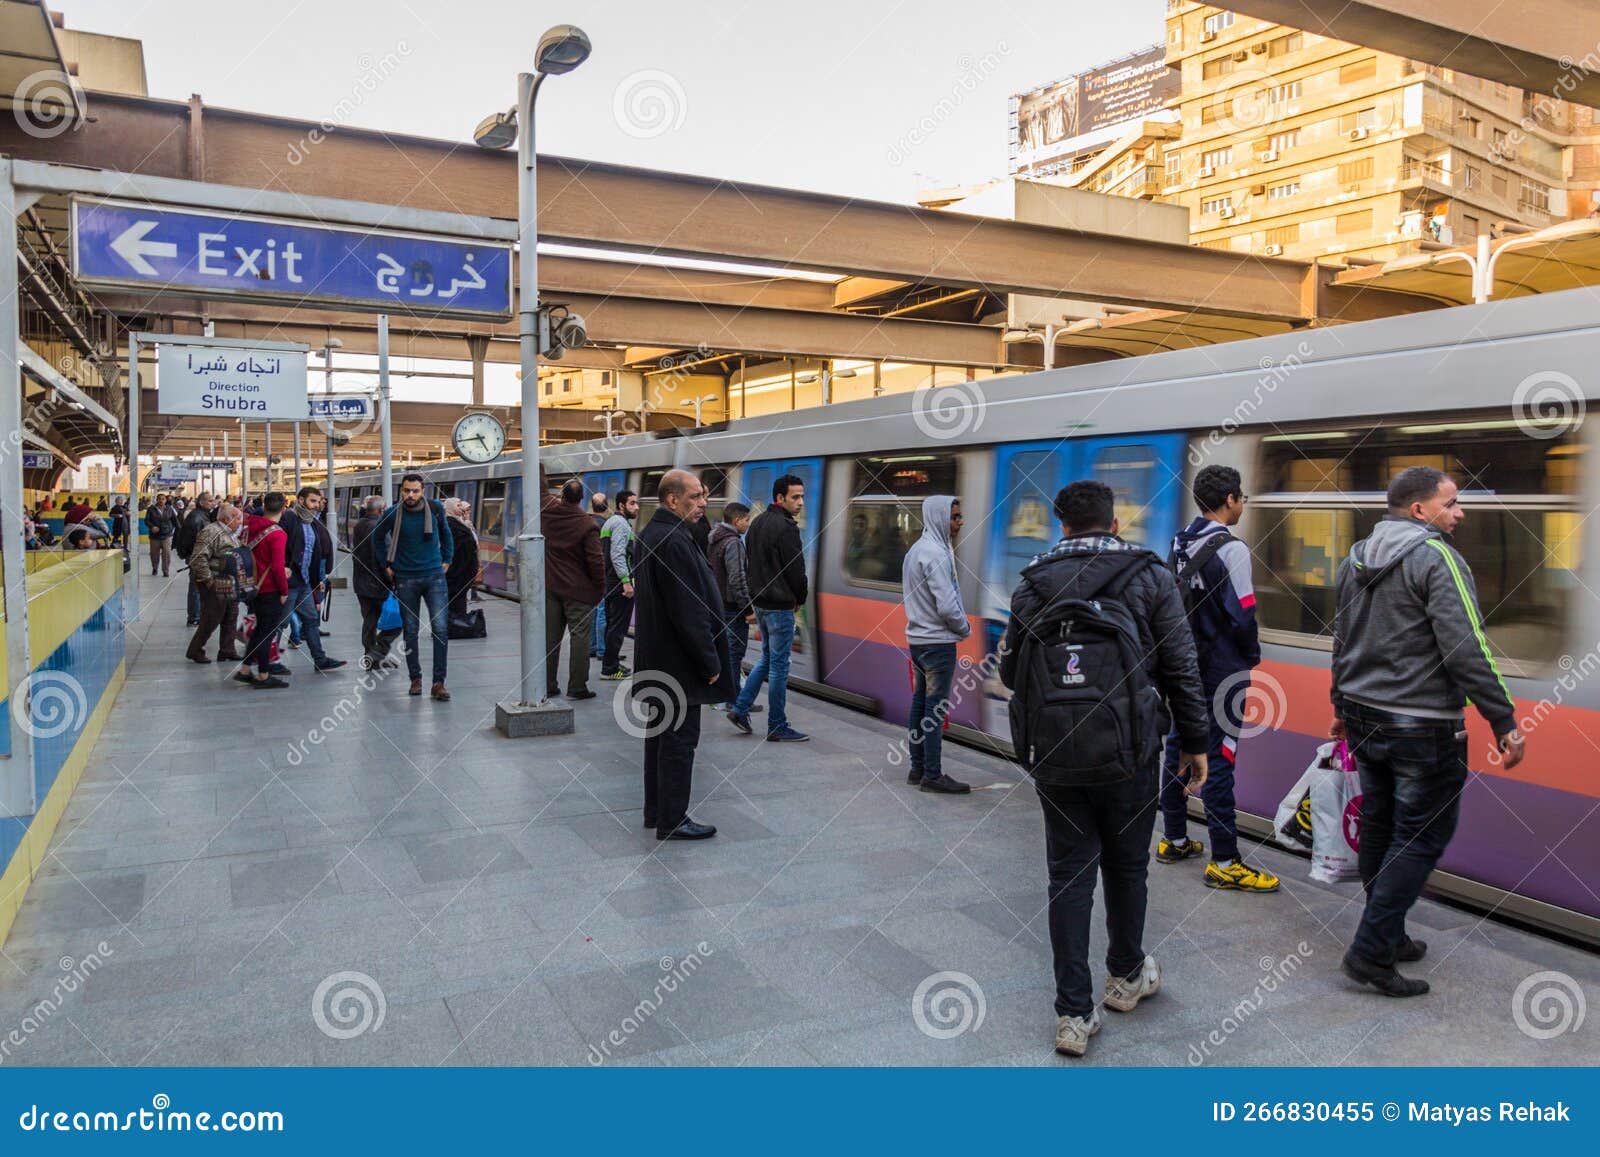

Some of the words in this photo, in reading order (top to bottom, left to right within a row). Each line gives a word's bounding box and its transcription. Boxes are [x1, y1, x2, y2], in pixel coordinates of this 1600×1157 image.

[198, 232, 303, 284] Exit
[376, 252, 488, 298] خروج
[188, 354, 227, 375] شبرا
[237, 357, 280, 377] اتجاه
[209, 381, 260, 392] Direction
[201, 394, 267, 411] Shubra
